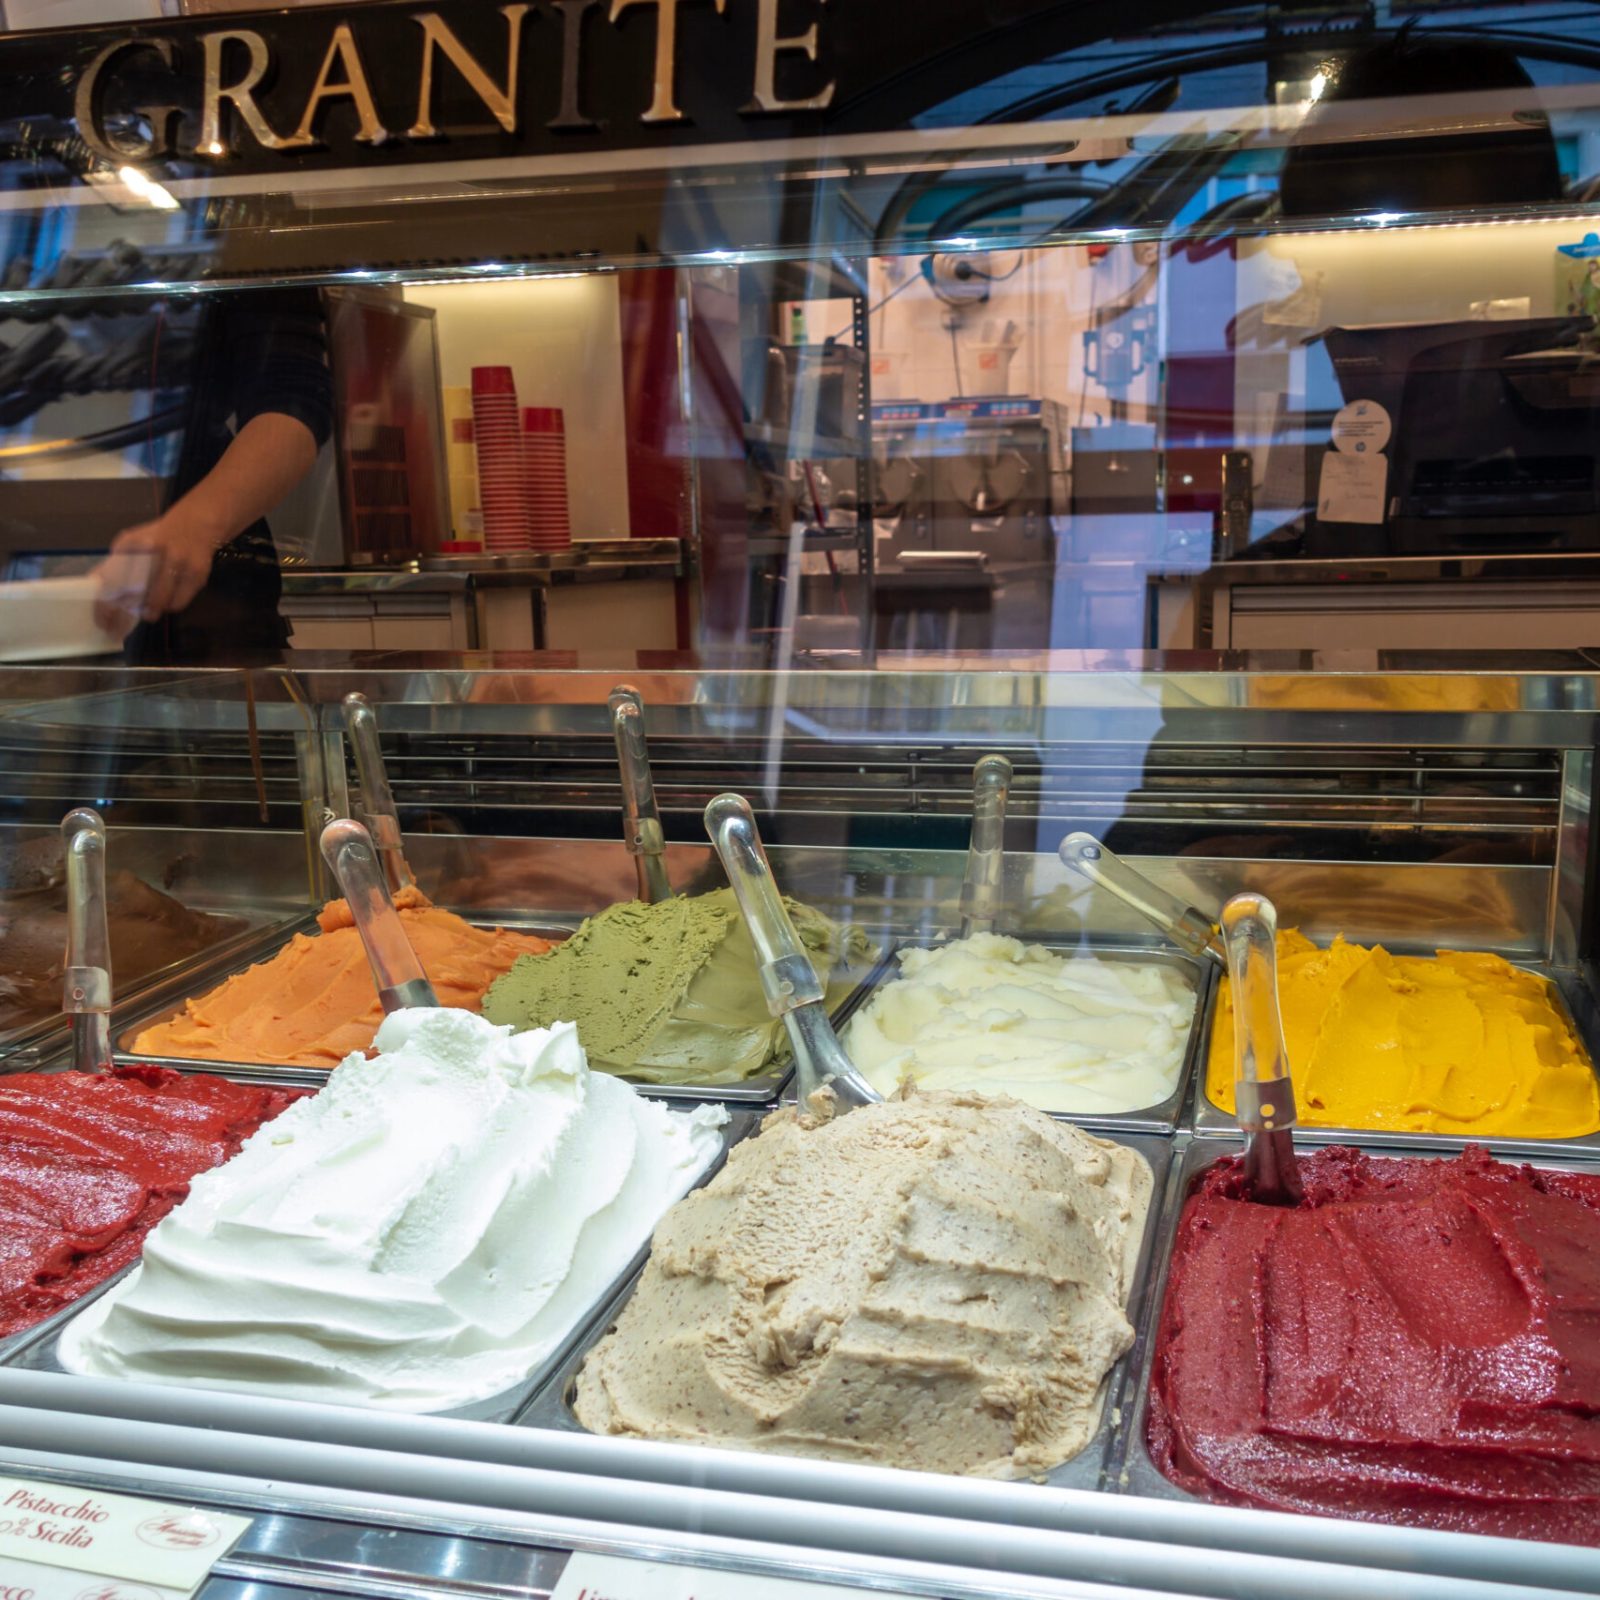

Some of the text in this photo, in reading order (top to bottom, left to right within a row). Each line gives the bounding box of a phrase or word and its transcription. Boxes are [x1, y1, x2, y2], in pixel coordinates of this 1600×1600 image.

[74, 0, 836, 162] GRANITE
[3, 1489, 110, 1523] Pistacchio
[27, 1520, 94, 1548] Sicilia
